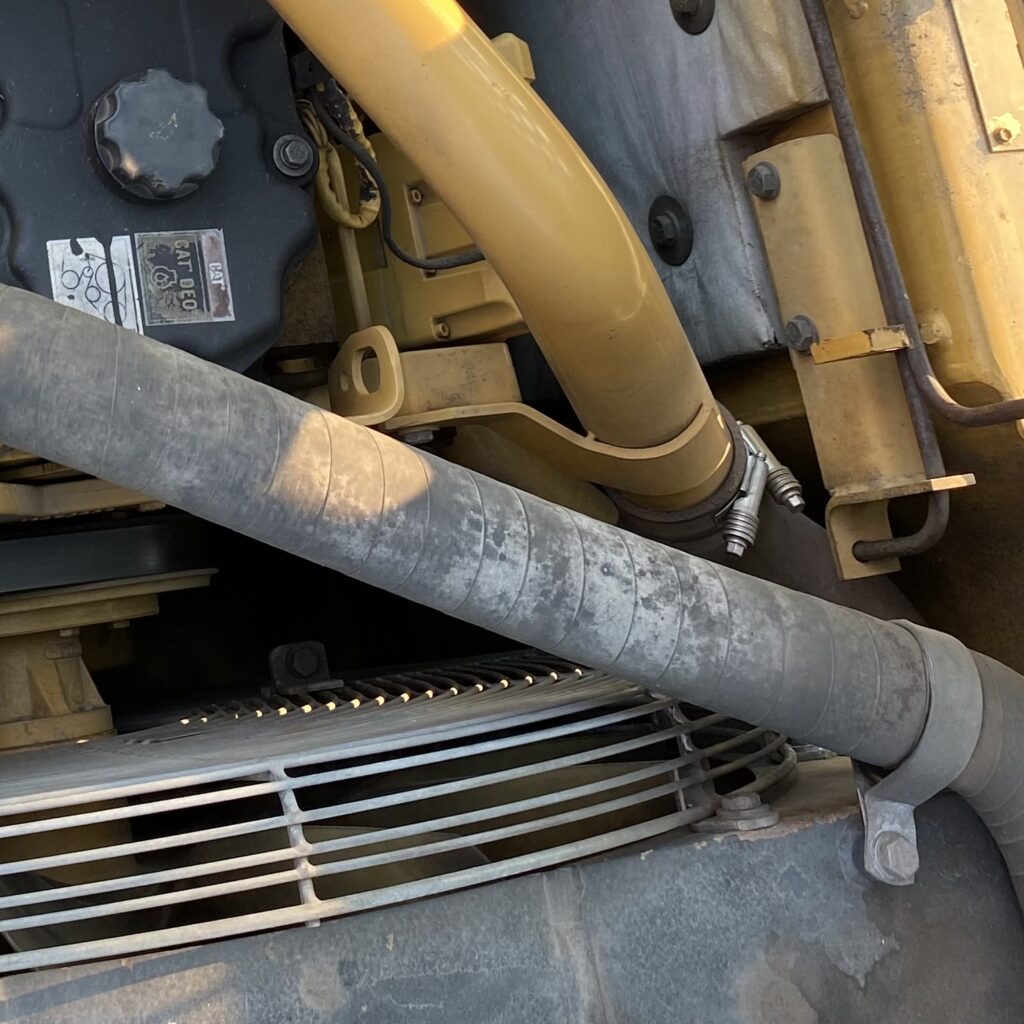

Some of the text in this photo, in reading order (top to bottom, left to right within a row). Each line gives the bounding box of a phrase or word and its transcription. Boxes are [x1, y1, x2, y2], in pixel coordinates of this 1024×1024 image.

[174, 239, 198, 310] CAT DEO
[208, 262, 226, 287] CAT
